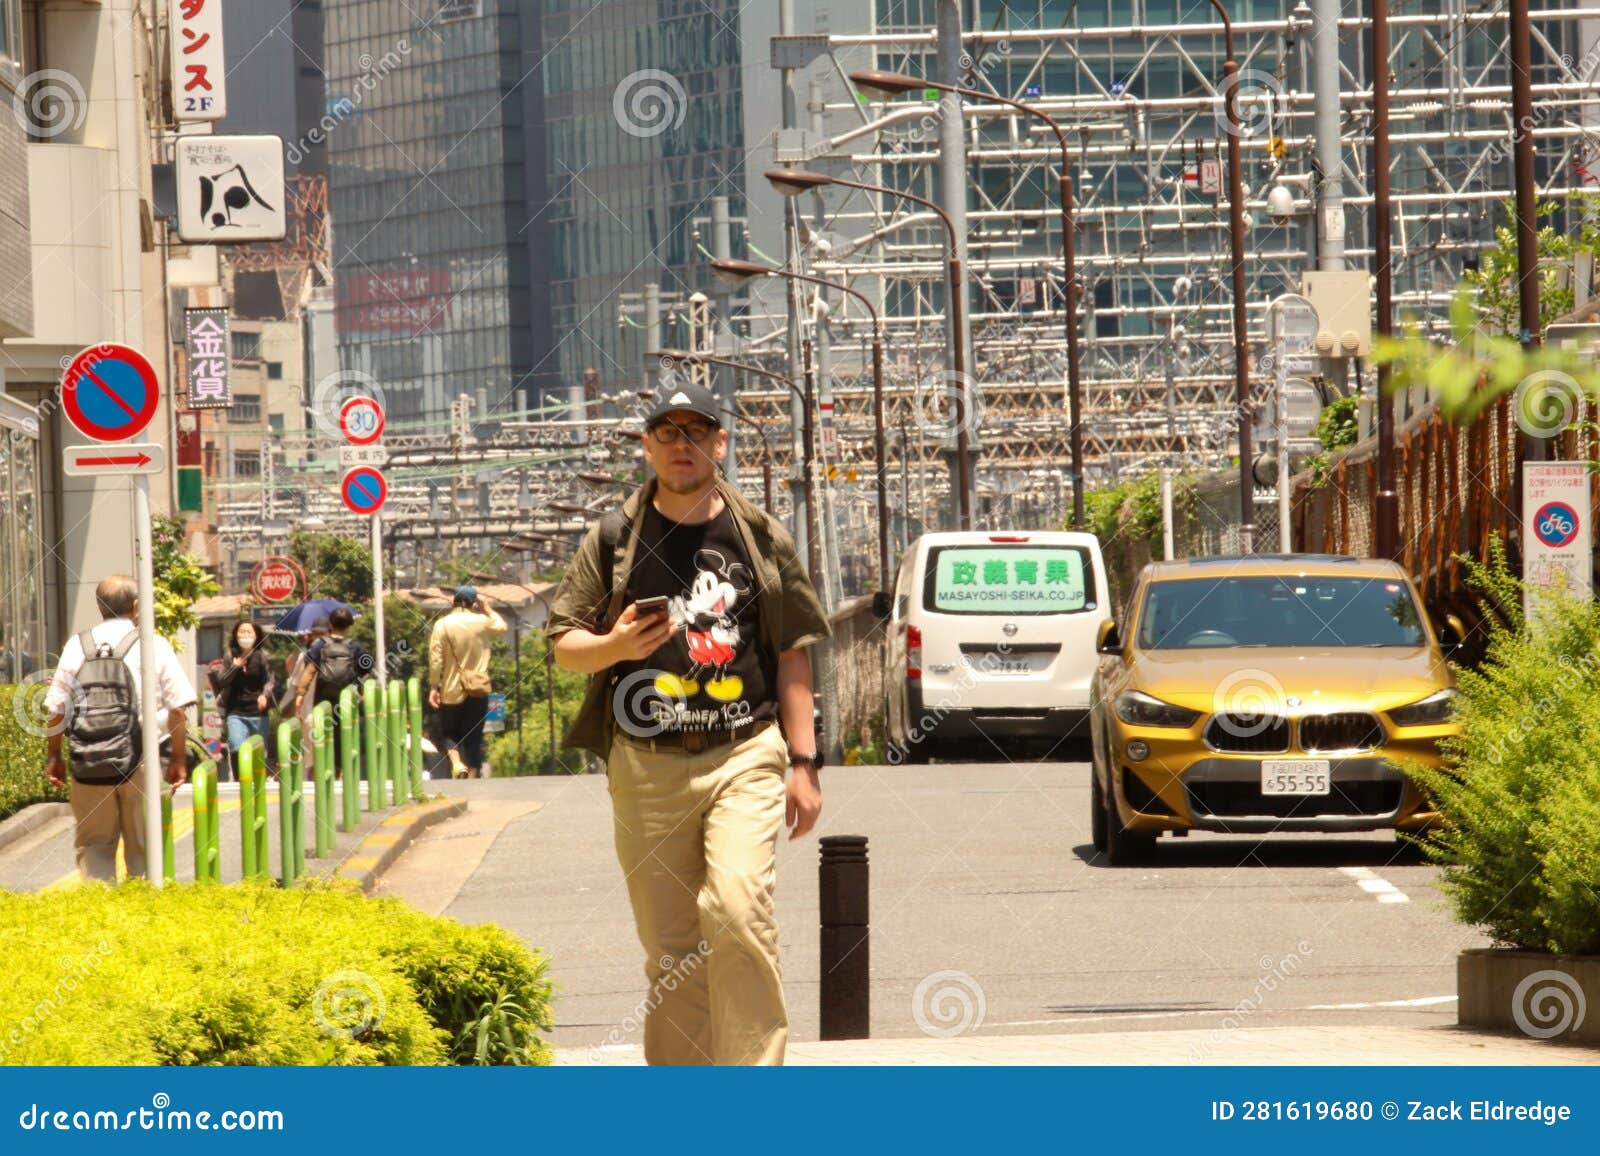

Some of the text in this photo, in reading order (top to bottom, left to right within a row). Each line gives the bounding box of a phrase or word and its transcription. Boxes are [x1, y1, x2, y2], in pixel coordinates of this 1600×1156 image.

[184, 97, 213, 111] 2F
[350, 411, 376, 433] 30
[952, 560, 1071, 586] 政義青果
[938, 590, 1084, 602] MASAYOSHI-SEIKA.CO.JP
[1277, 775, 1326, 792] 55-55
